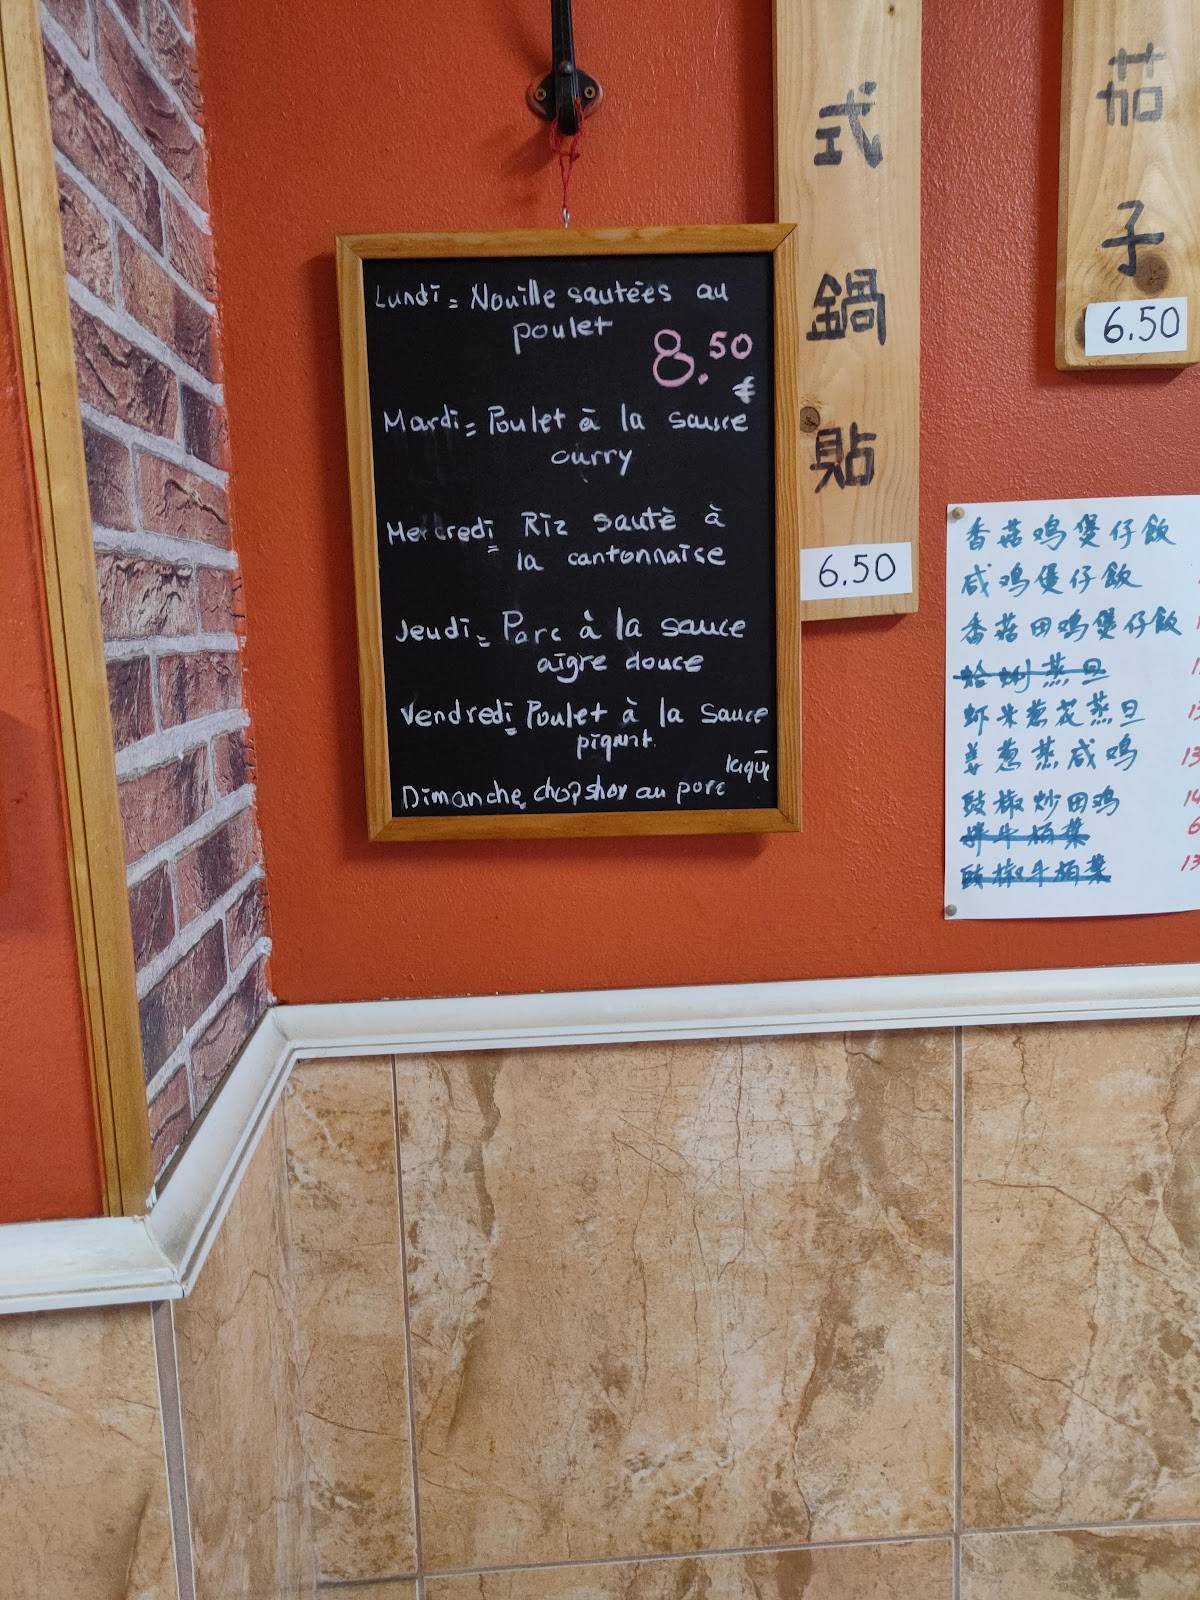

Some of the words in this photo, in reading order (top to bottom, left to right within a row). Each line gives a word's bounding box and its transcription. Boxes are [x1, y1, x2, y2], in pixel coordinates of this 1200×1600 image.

[1096, 42, 1166, 278] 茄子
[376, 282, 441, 309] Lundi
[470, 278, 556, 312] Nouille
[696, 282, 730, 302] au
[512, 314, 614, 355] poulet
[1103, 305, 1181, 344] 6.50
[383, 403, 459, 433] Mardi
[487, 405, 566, 435] Poulet
[621, 402, 646, 432] la
[520, 510, 569, 538] Riz
[704, 502, 727, 528] à
[516, 549, 545, 571] la
[818, 552, 898, 589] 6.50
[395, 615, 470, 643] Jeudi
[579, 608, 602, 640] à
[616, 606, 643, 641] la
[660, 616, 747, 639] sauce
[536, 652, 608, 684] aigre
[625, 650, 705, 673] douce
[400, 698, 514, 728] Vendredi
[526, 699, 609, 730] Poulet
[622, 695, 641, 724] à
[659, 696, 686, 729] la
[635, 785, 667, 800] au
[676, 779, 727, 805] porc
